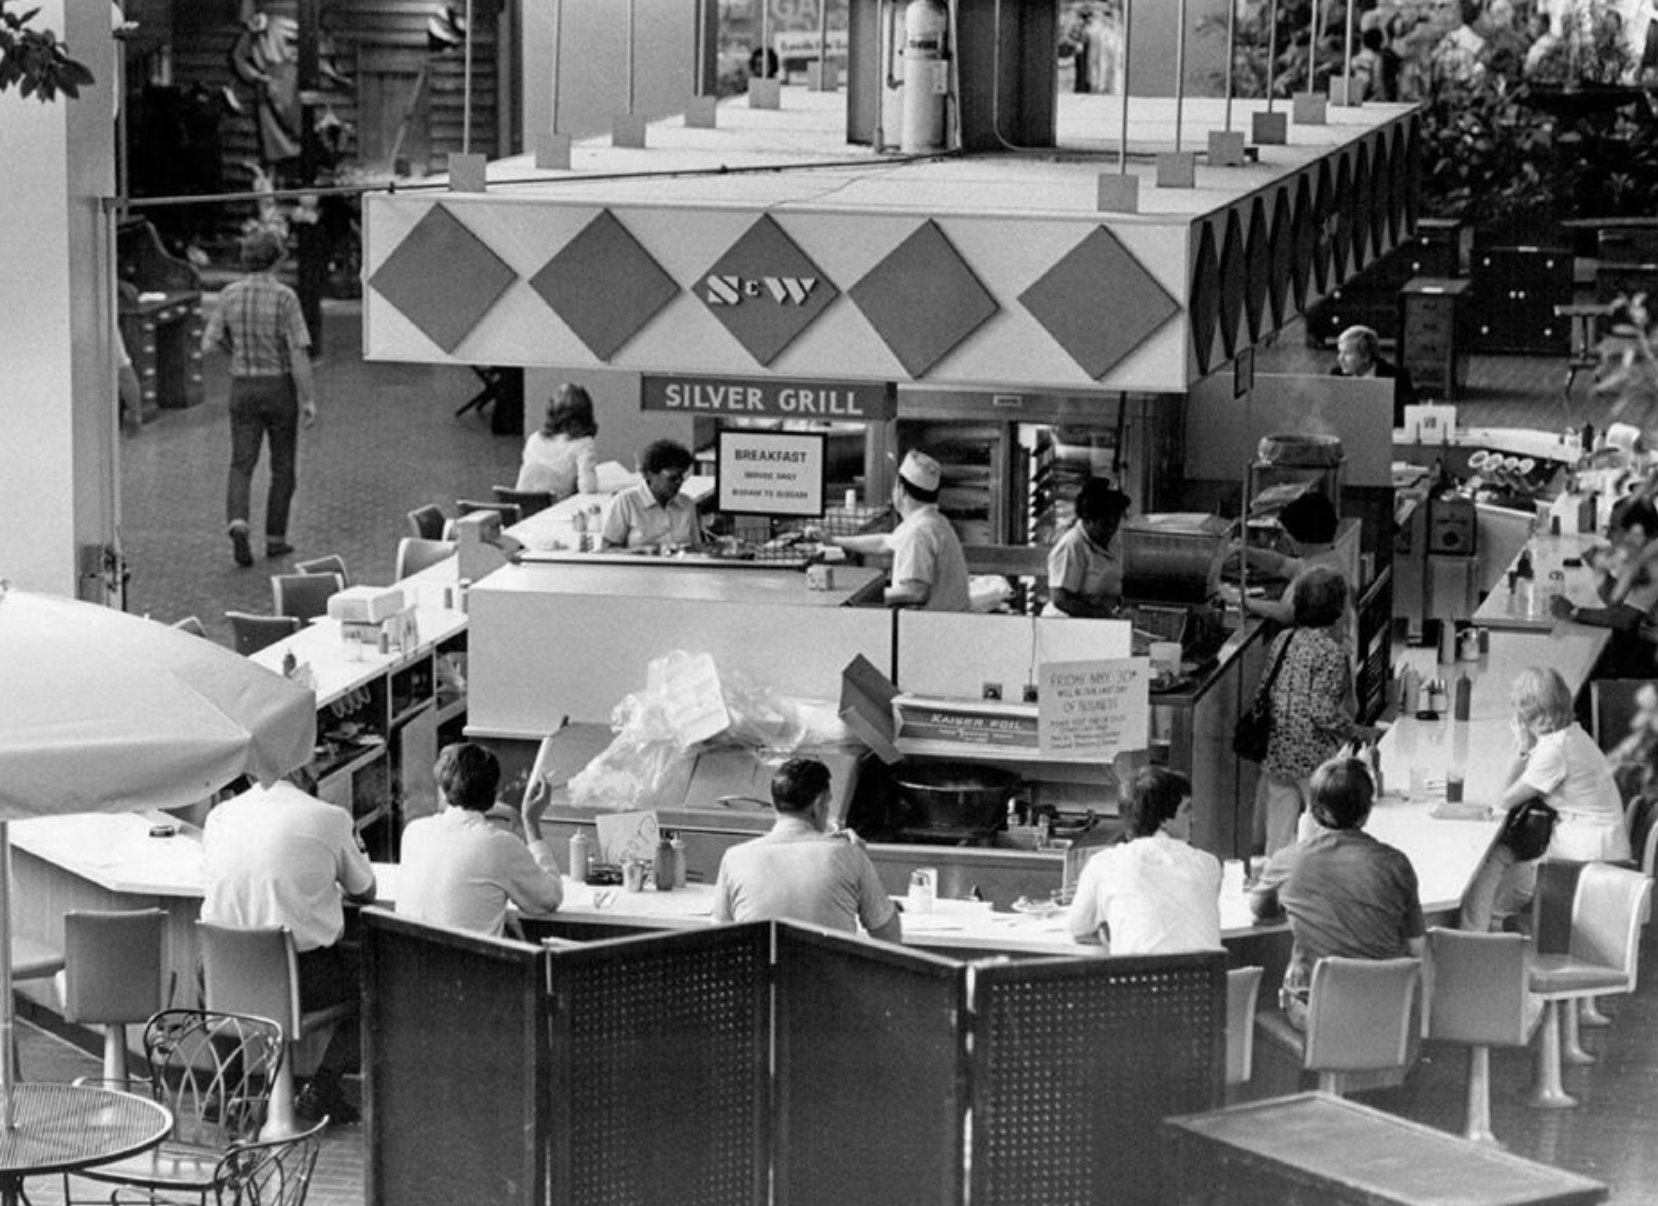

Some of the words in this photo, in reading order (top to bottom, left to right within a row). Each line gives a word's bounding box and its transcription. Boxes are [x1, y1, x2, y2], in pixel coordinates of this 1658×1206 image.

[665, 384, 765, 410] SILVER
[778, 389, 864, 415] GRILL
[735, 449, 807, 463] BREAKFAST
[1050, 673, 1085, 687] FRIDAY
[1089, 671, 1110, 684] MAY
[1062, 700, 1075, 713] OF
[931, 713, 984, 727] KAISER
[990, 719, 1022, 730] FOIL
